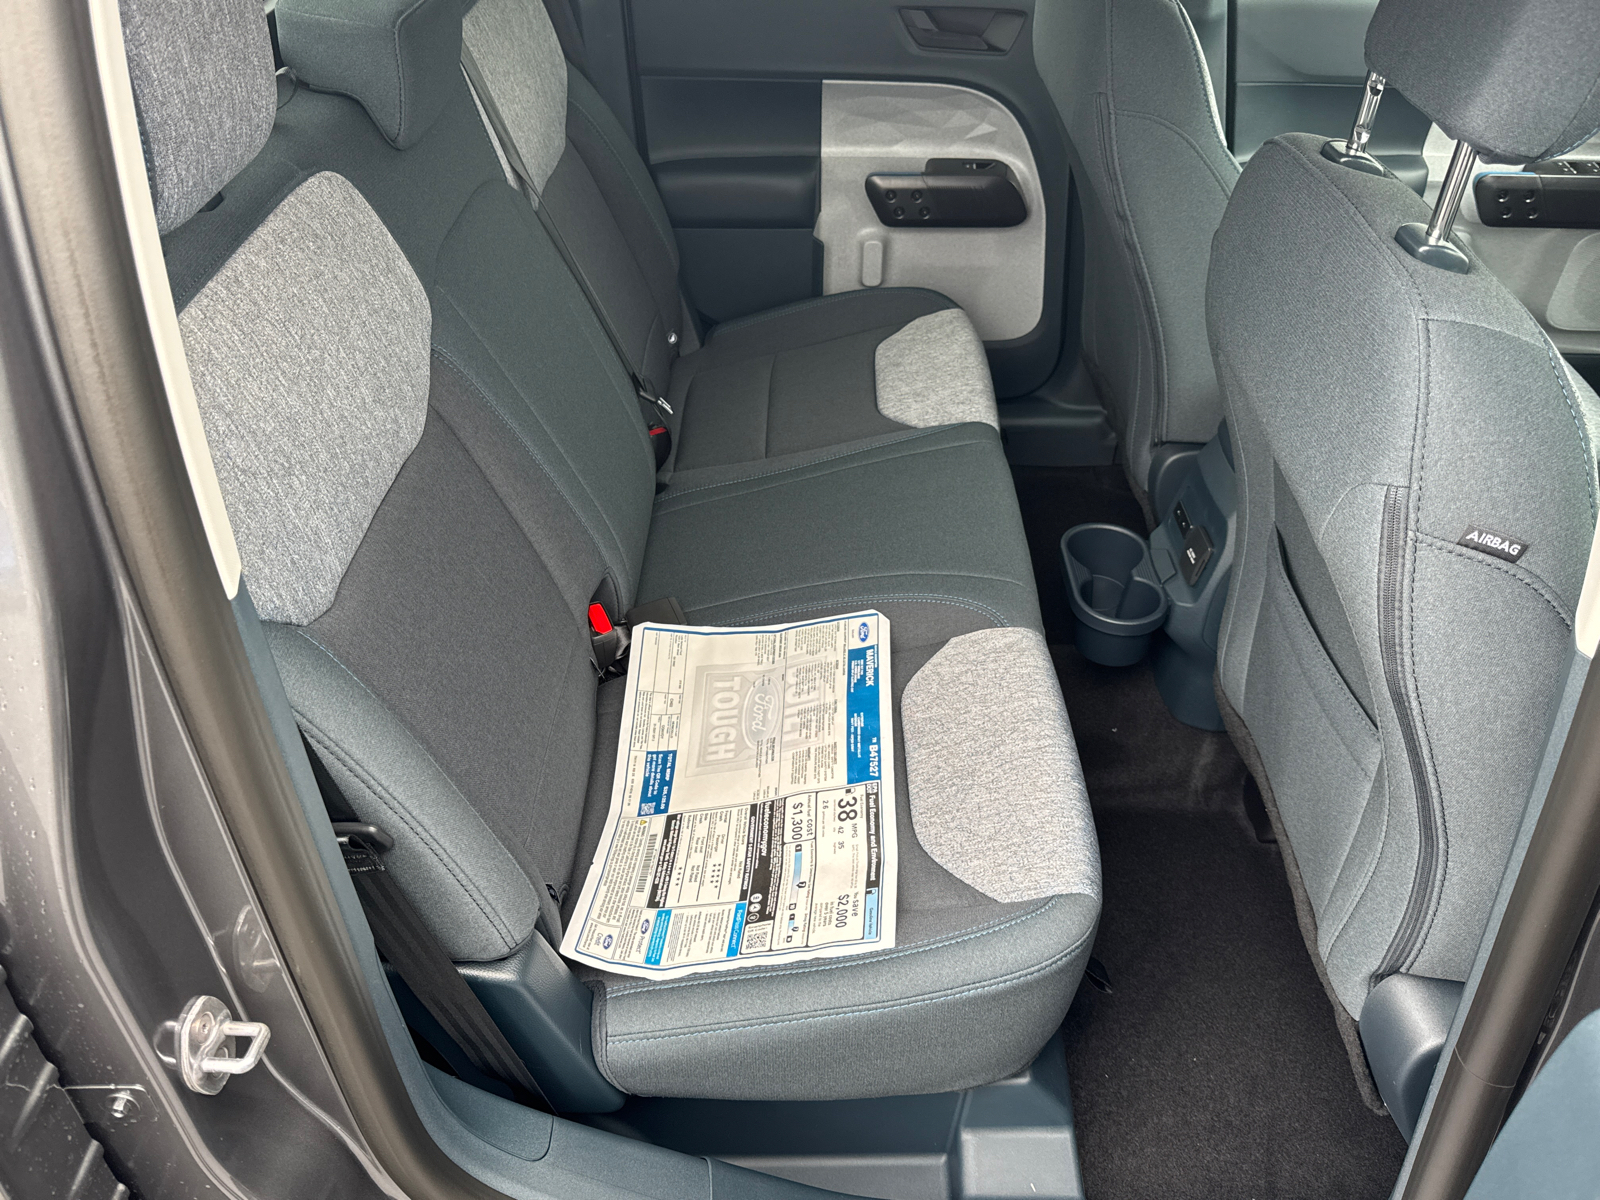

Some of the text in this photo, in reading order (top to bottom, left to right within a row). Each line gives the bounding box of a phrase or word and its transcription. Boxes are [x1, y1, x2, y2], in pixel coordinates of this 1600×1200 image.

[1465, 530, 1521, 556] AIRBAG
[859, 624, 868, 640] Ford
[866, 649, 874, 686] MAVERICK
[706, 676, 742, 762] TOUGH
[751, 693, 774, 732] Ford
[869, 744, 878, 777] B47527
[791, 802, 804, 840] $1,300
[838, 796, 858, 822] 38
[838, 826, 844, 834] 42
[838, 841, 844, 849] 35
[870, 848, 878, 881] Environment
[835, 894, 850, 928] $2,000
